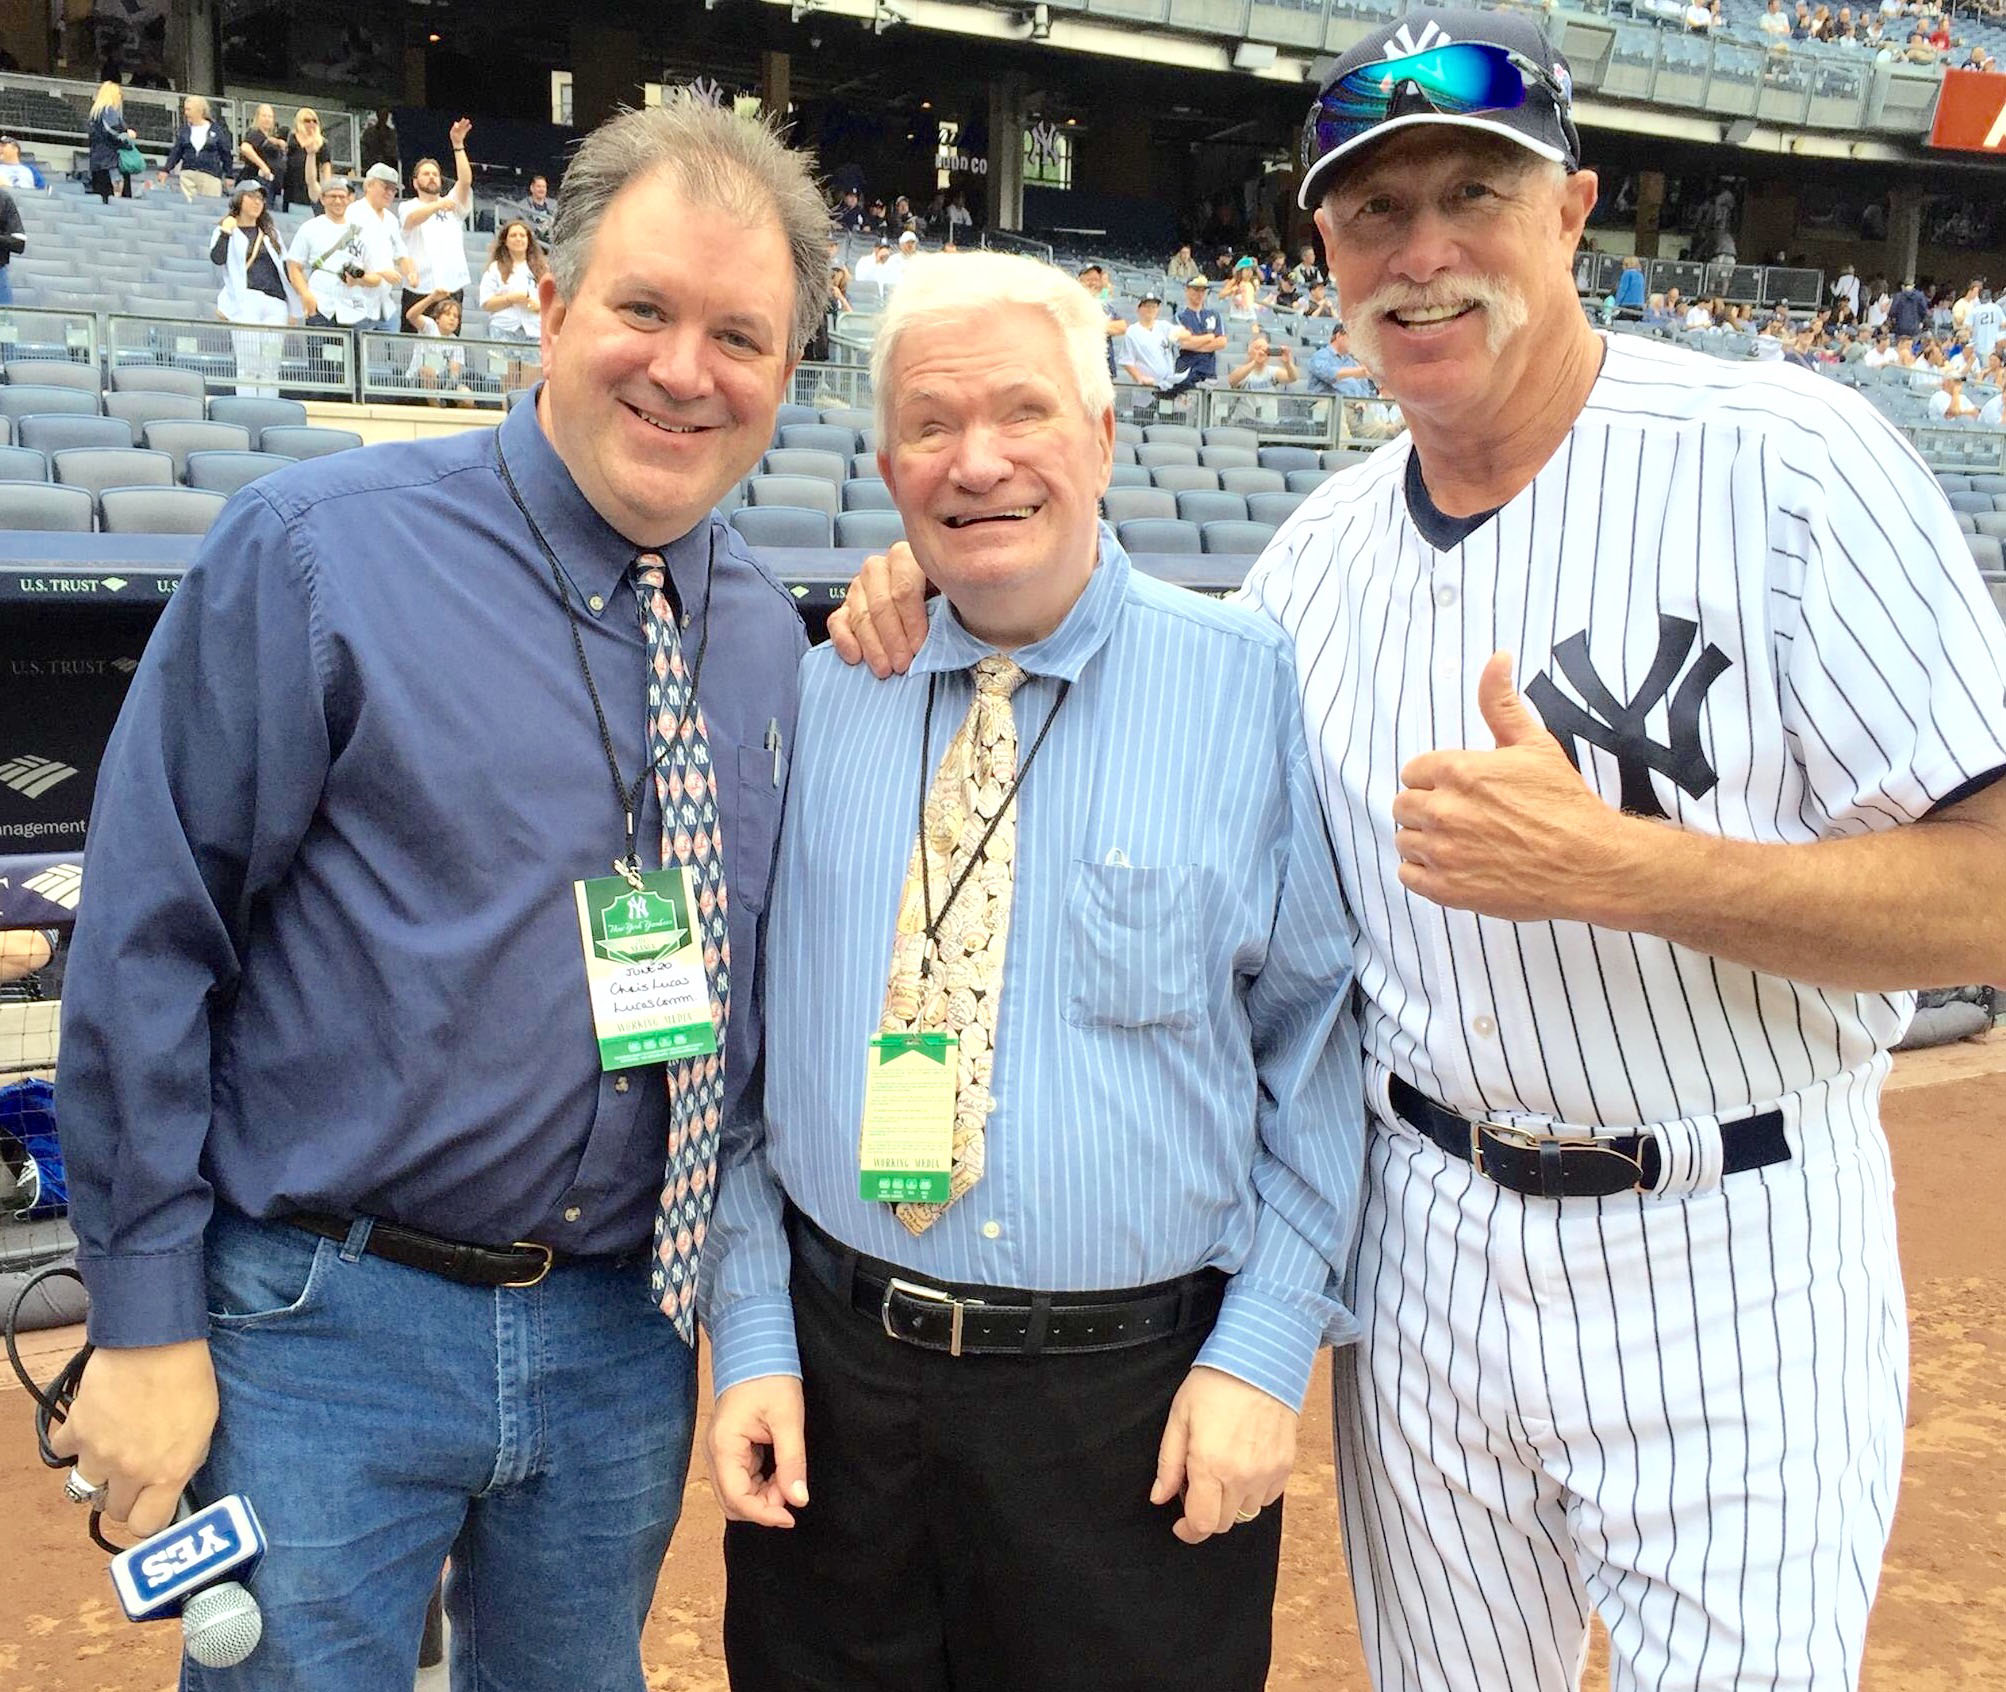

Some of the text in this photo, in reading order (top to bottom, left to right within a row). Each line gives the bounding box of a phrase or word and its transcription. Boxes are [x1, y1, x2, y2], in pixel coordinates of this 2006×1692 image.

[1980, 311, 1994, 325] 21
[20, 579, 99, 592] U.S. TRUST
[157, 579, 180, 593] U.S
[829, 587, 846, 599] U.S
[47, 660, 106, 675] TRUST
[1524, 612, 1733, 821] NY
[0, 820, 86, 838] nagement
[610, 978, 690, 995] Chris Lucas
[874, 1157, 940, 1168] WORKING MEDIA
[141, 1523, 231, 1588] YES
